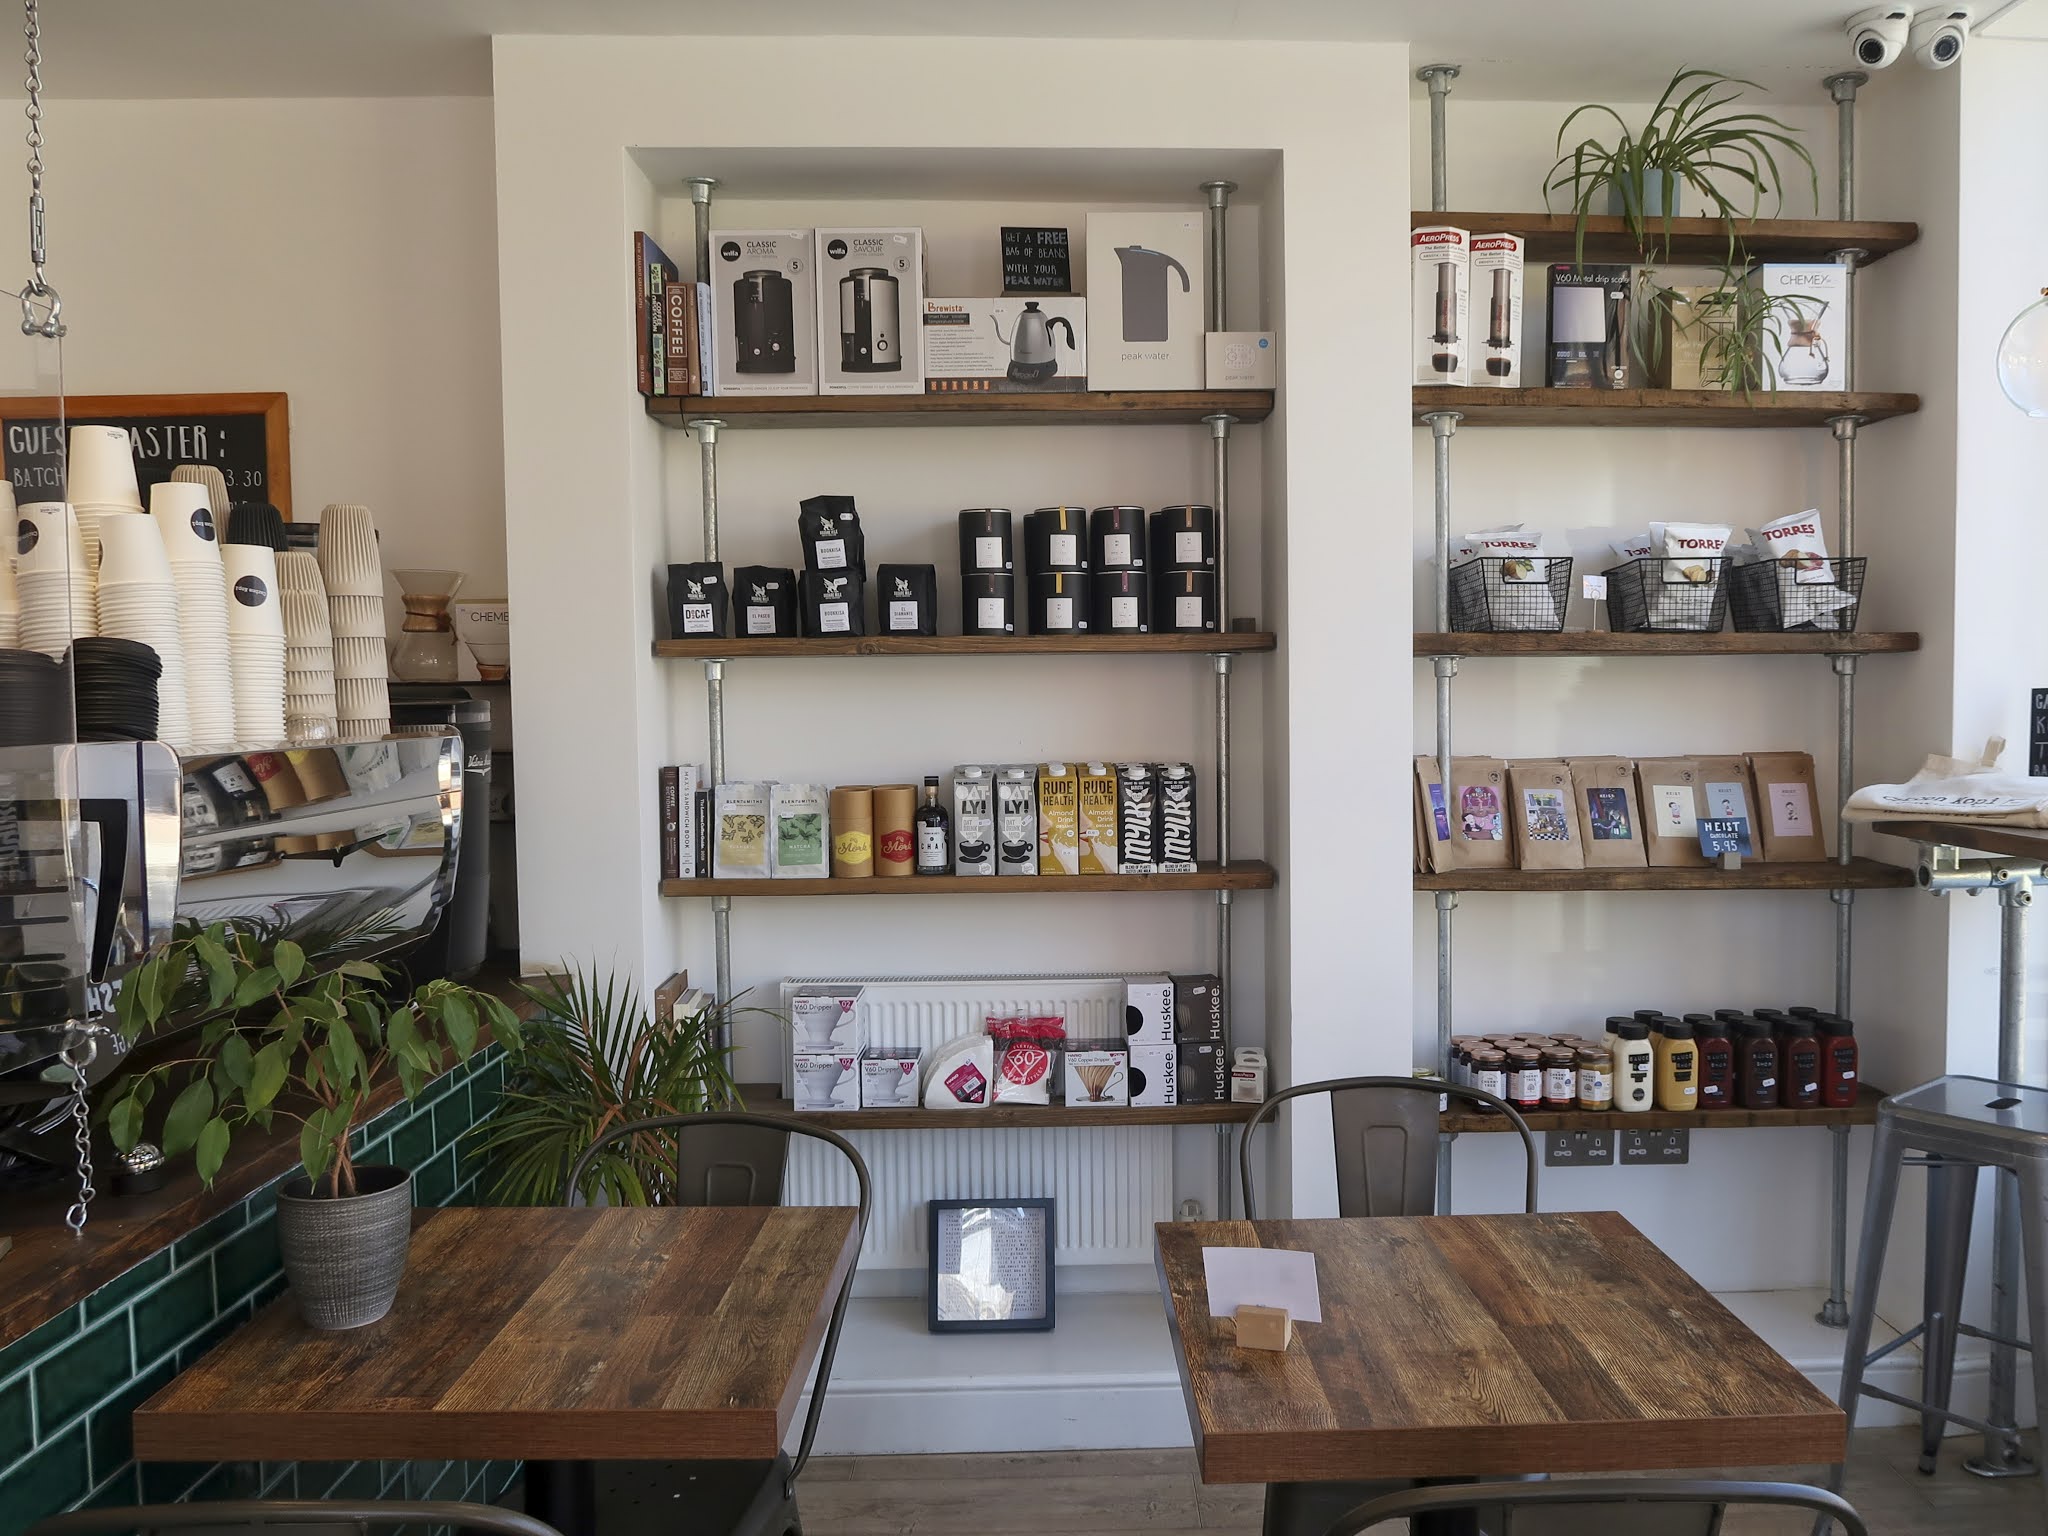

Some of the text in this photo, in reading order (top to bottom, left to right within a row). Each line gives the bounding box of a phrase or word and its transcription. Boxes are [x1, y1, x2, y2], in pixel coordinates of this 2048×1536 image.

[1006, 232, 1067, 244] GET A FREE
[1006, 246, 1066, 258] BAG OF BEANS
[792, 262, 798, 270] 5
[1006, 264, 1056, 275] WITH YOUR
[1005, 276, 1064, 287] PEAK WATER
[1556, 274, 1572, 282] V60
[1595, 274, 1609, 285] drip
[928, 302, 963, 312] Brewista
[671, 295, 683, 354] COFFEE
[1122, 352, 1142, 362] peak
[9, 425, 72, 456] GUES
[1762, 524, 1815, 541] TORRES
[1481, 541, 1537, 549] TORRES
[1678, 539, 1724, 549] TORRE
[470, 612, 508, 622] CHEME
[1044, 781, 1073, 794] RUDE
[1084, 781, 1113, 794] RUDE
[962, 800, 986, 814] LY!
[1005, 800, 1029, 814] LY!
[1044, 796, 1074, 806] HEALTH
[1084, 796, 1113, 806] HEALTH
[1705, 822, 1740, 831] HEIST
[1712, 840, 1738, 852] 5.95
[1161, 986, 1171, 1041] Huskee.
[1209, 985, 1220, 1039] Huskee.
[1164, 1050, 1174, 1104] Huskee.
[1214, 1045, 1224, 1100] Huskee.
